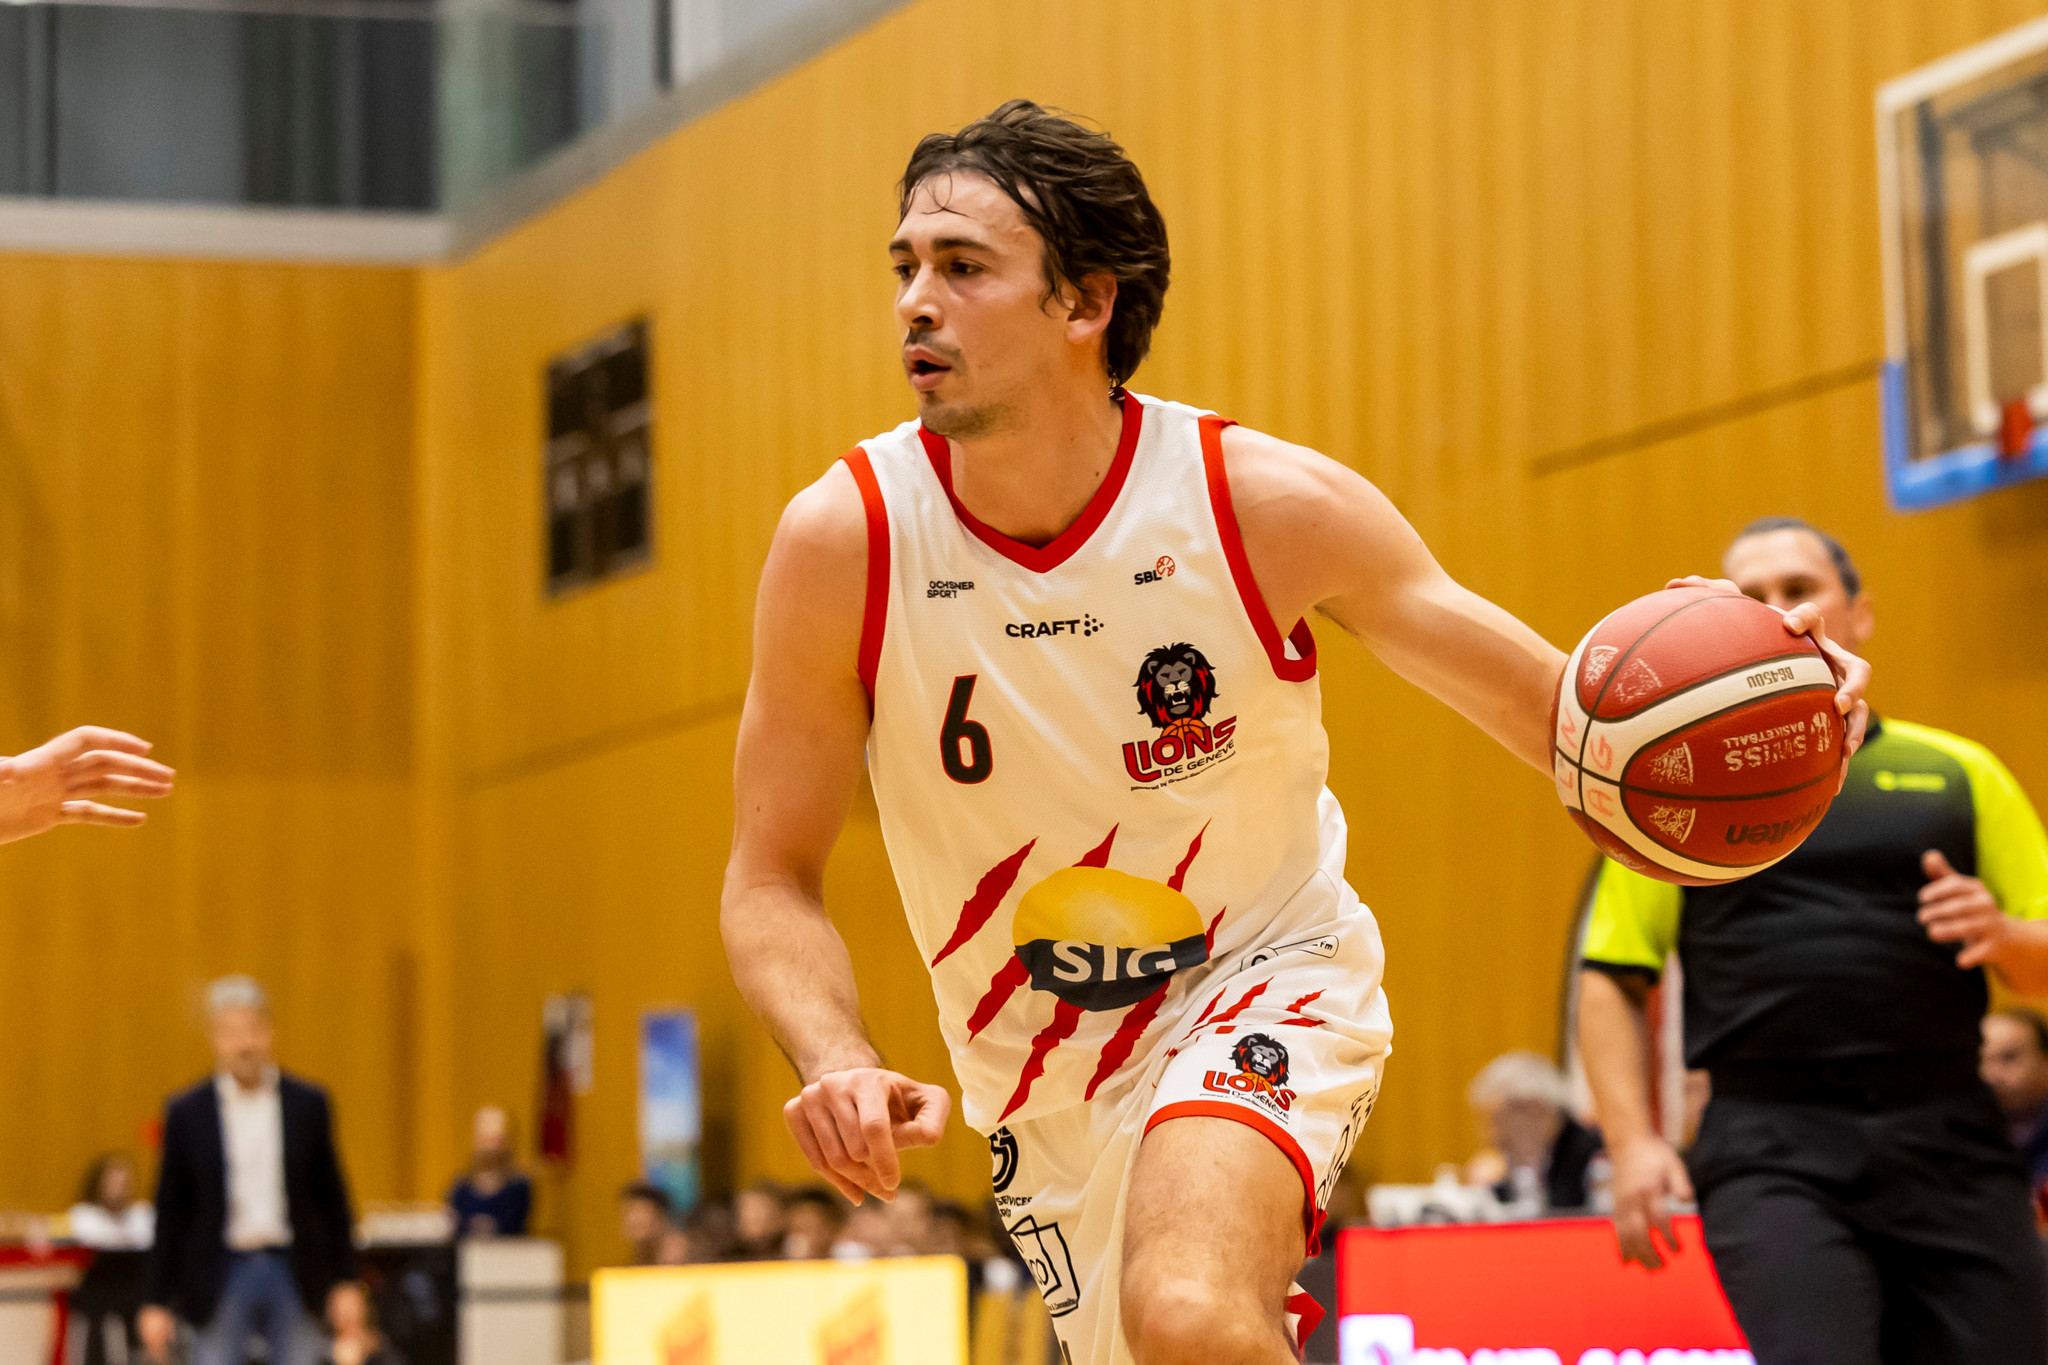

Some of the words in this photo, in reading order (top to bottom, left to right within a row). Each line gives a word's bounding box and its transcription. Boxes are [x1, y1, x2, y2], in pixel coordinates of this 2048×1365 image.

[929, 580, 975, 591] OCHSNER
[1134, 569, 1162, 585] SBL
[927, 589, 957, 599] SPORT
[1005, 619, 1081, 638] CRAFT
[940, 674, 993, 784] 6
[1724, 721, 1805, 749] BASKETBALL
[1122, 715, 1238, 783] LIONS
[1164, 764, 1184, 777] DE
[1052, 939, 1177, 983] SIG
